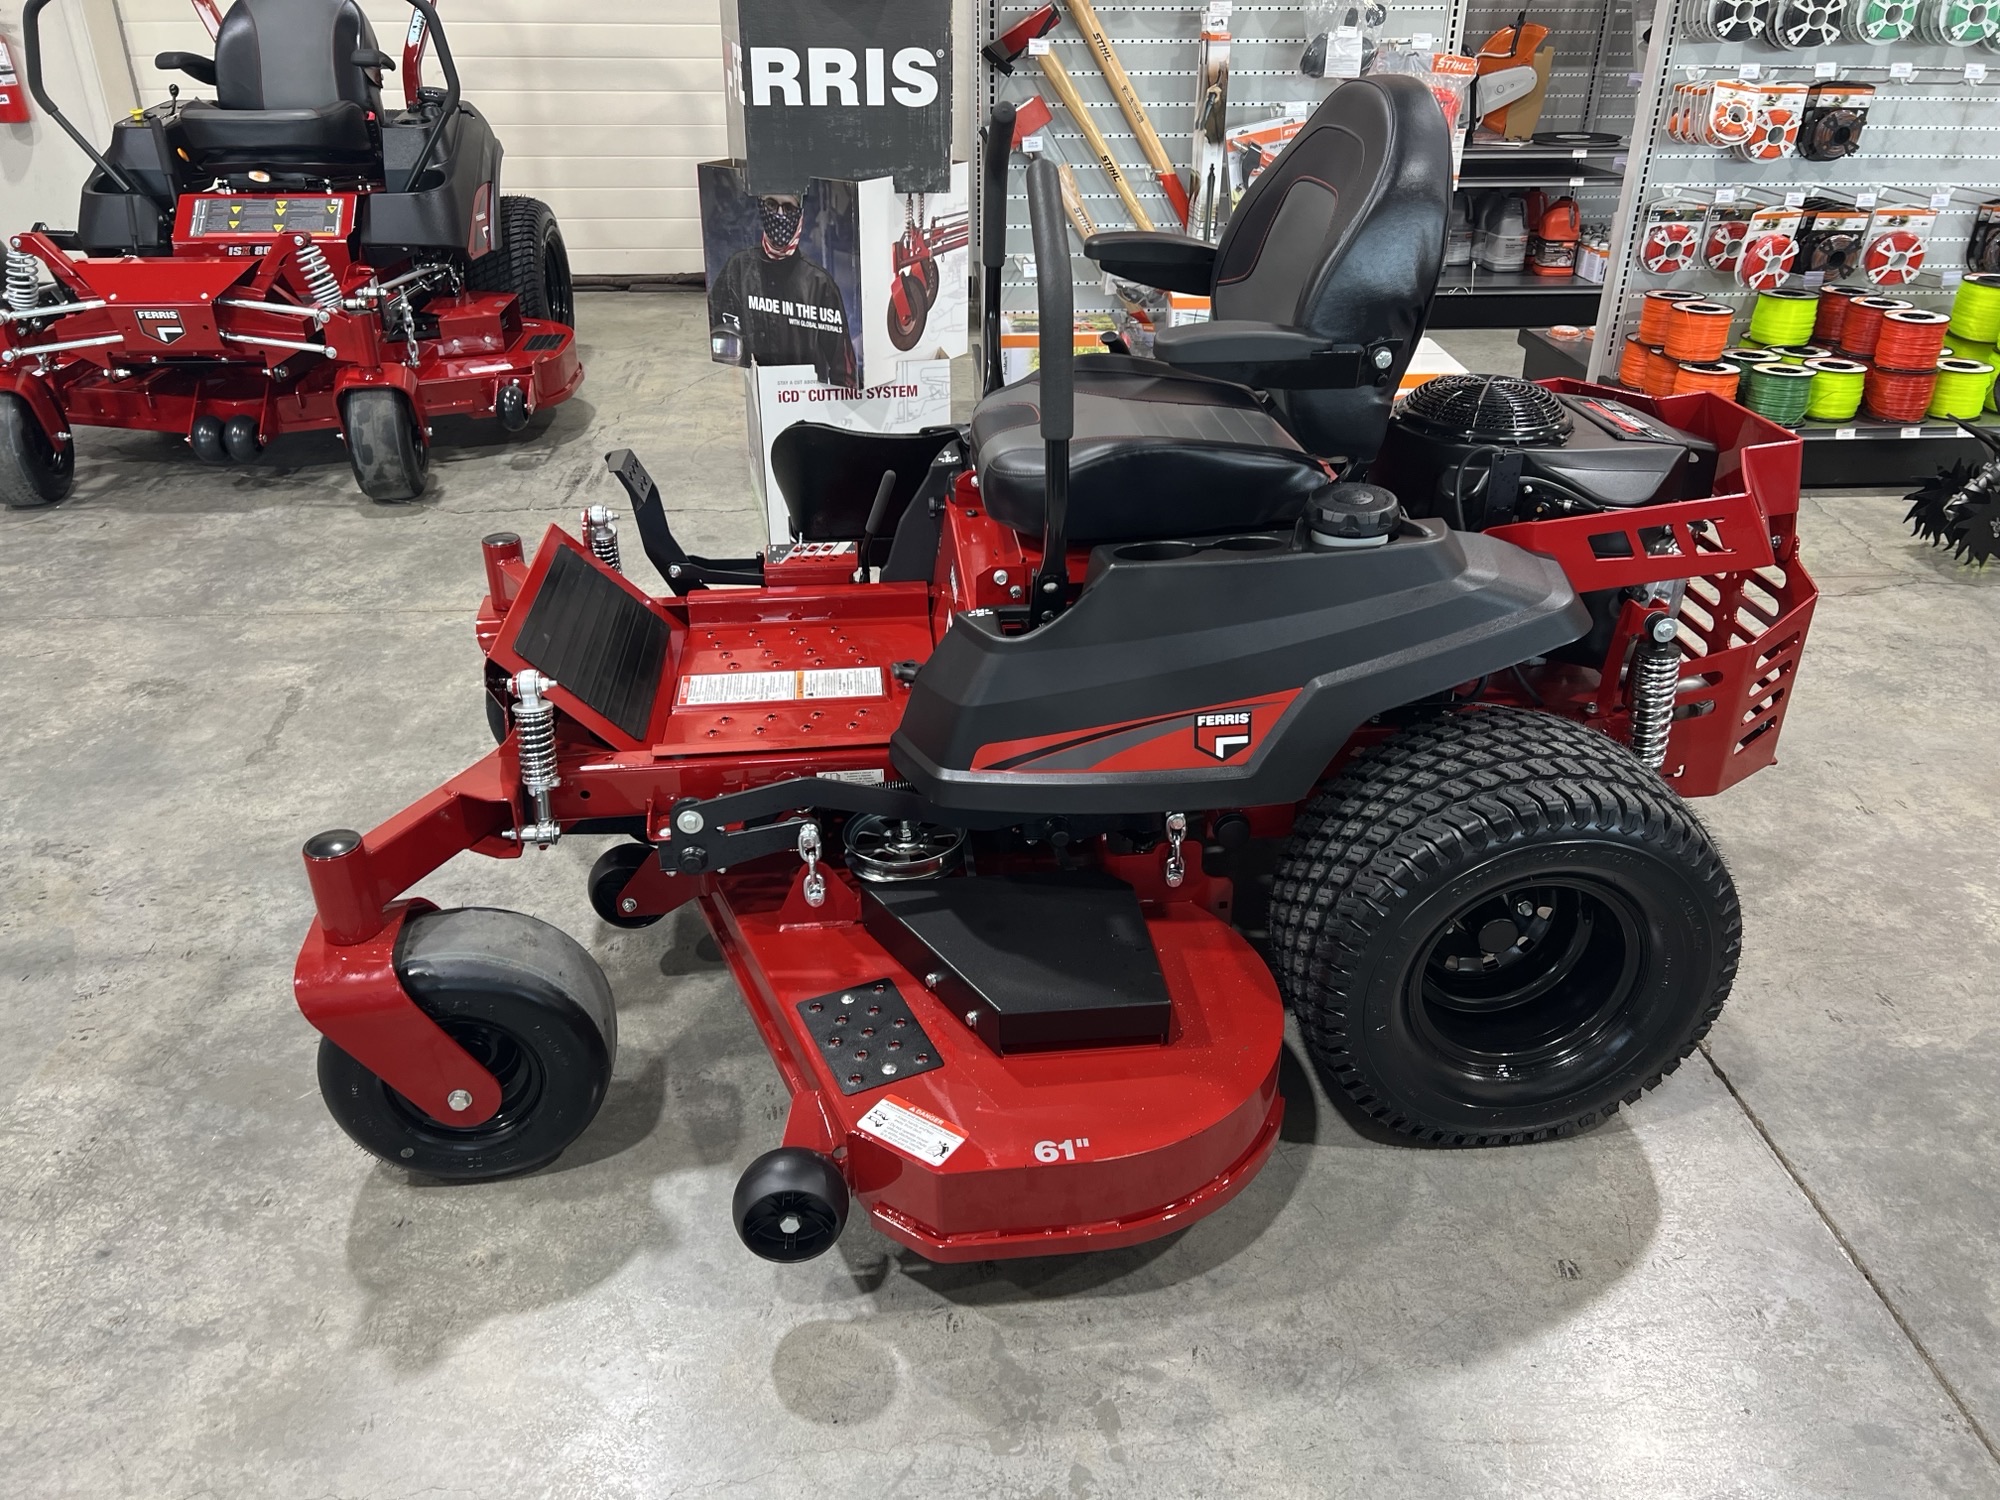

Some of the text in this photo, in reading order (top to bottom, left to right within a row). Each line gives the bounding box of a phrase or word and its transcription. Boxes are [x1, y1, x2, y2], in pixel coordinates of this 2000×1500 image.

[1093, 32, 1112, 62] STIHL
[1436, 60, 1469, 71] STIHL
[1101, 155, 1120, 182] STIHL
[1073, 207, 1092, 234] STIHL
[137, 311, 178, 319] FERRIS
[748, 295, 842, 324] MADE IN THE USA
[800, 320, 817, 329] GLOBAL
[818, 323, 842, 334] MATERIALS
[808, 387, 862, 402] CUTTING
[866, 385, 918, 399] SYSTEM
[1197, 712, 1250, 727] FERRIS
[915, 1108, 944, 1126] DANGER
[1034, 1138, 1089, 1163] 61"
